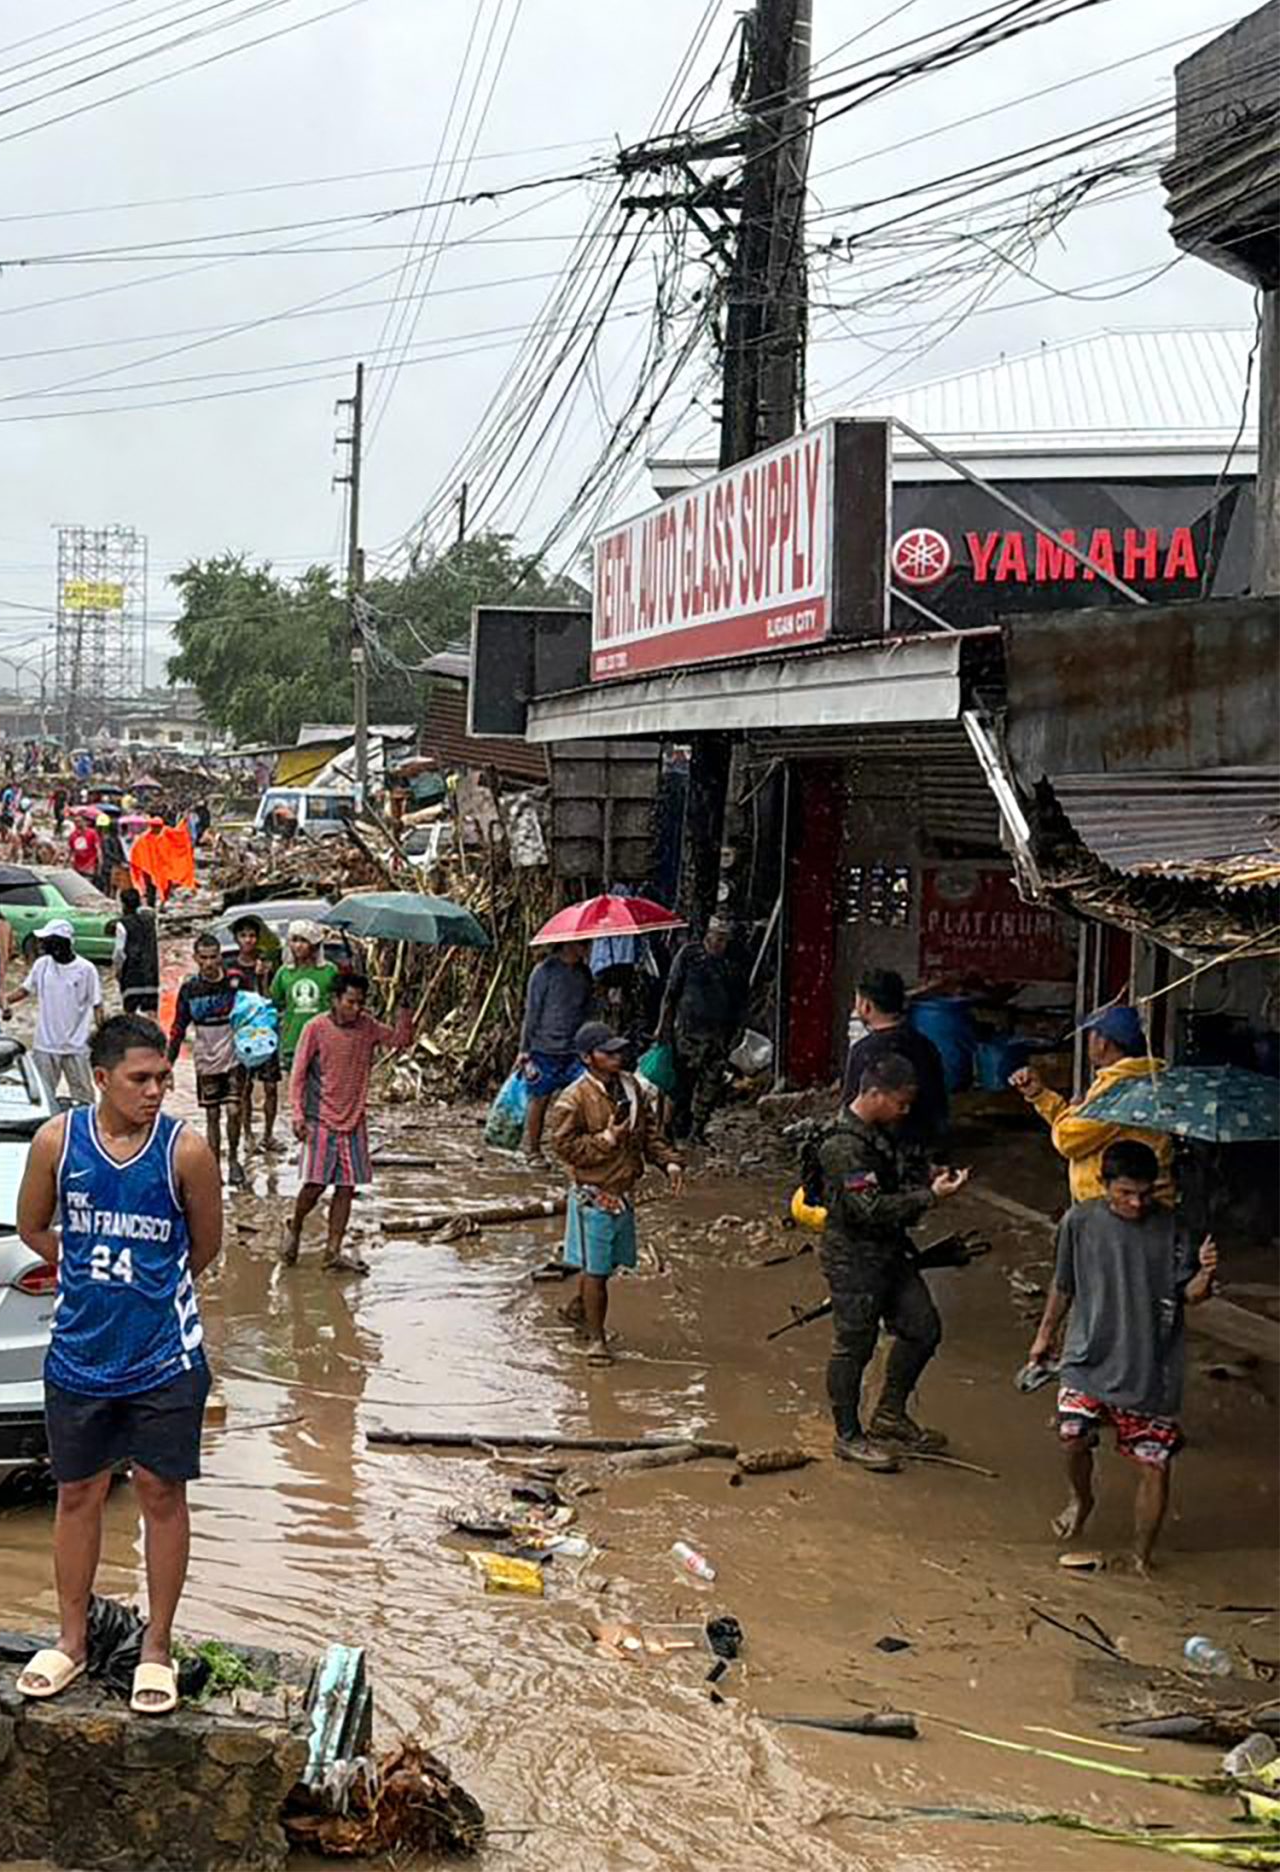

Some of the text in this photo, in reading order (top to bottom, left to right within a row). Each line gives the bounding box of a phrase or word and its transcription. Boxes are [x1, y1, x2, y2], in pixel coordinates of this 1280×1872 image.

[639, 506, 678, 632] AUTO
[681, 479, 735, 620] GLASS
[739, 437, 821, 606] SUPPLY
[966, 527, 1198, 582] YAMAHA
[795, 608, 817, 634] CITY
[68, 1209, 172, 1242] SAN FRANCISCO
[90, 1245, 133, 1283] 24
